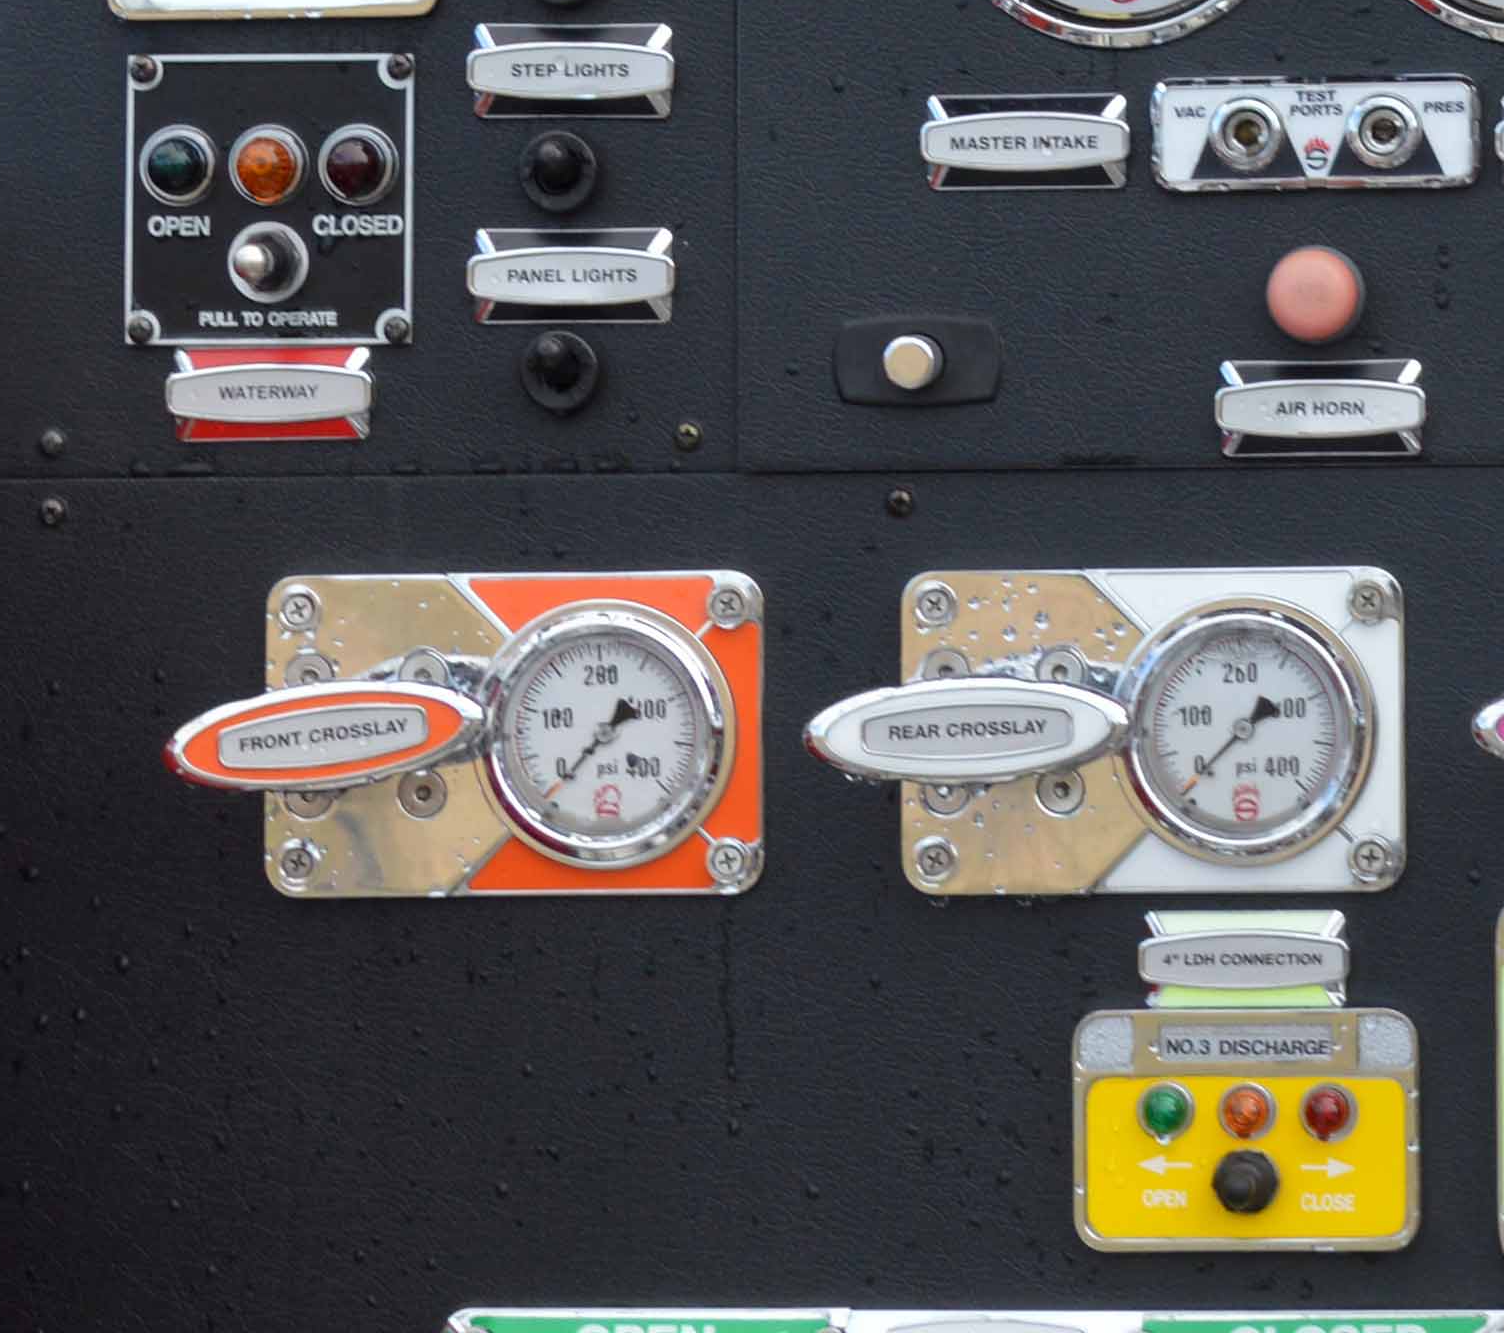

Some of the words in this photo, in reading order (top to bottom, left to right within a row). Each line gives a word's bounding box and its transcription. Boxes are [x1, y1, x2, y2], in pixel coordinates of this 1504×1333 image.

[511, 63, 557, 78] STEP
[564, 63, 630, 78] LIGHTS
[1297, 90, 1337, 104] TEST
[1175, 105, 1207, 119] VAC
[1290, 103, 1343, 117] PORTS
[1424, 101, 1465, 115] PRES
[950, 136, 1024, 151] MASTER
[1030, 134, 1098, 150] INTAKE
[147, 215, 211, 238] OPEN
[312, 214, 404, 238] CLOSED
[507, 268, 565, 283] PANEL
[572, 268, 638, 283] LIGHTS
[199, 311, 238, 328] PULL
[242, 311, 264, 328] TO
[268, 310, 338, 327] OPERATE
[218, 384, 319, 401] WATERWAY
[1275, 399, 1308, 416] AIR
[1313, 399, 1365, 416] HORN
[239, 733, 301, 753] FRONT
[308, 718, 409, 745] CROSSLAY
[888, 723, 942, 740] REAR
[946, 719, 1048, 737] CROSSLAY
[1162, 952, 1180, 967] 4"
[1184, 952, 1217, 967] LDH
[1220, 952, 1323, 966] CONNECTION
[1165, 1039, 1210, 1057] NO.3
[1219, 1038, 1331, 1057] DISCHARGE
[1142, 1189, 1188, 1209] OPEN
[1301, 1192, 1355, 1213] CLOSE
